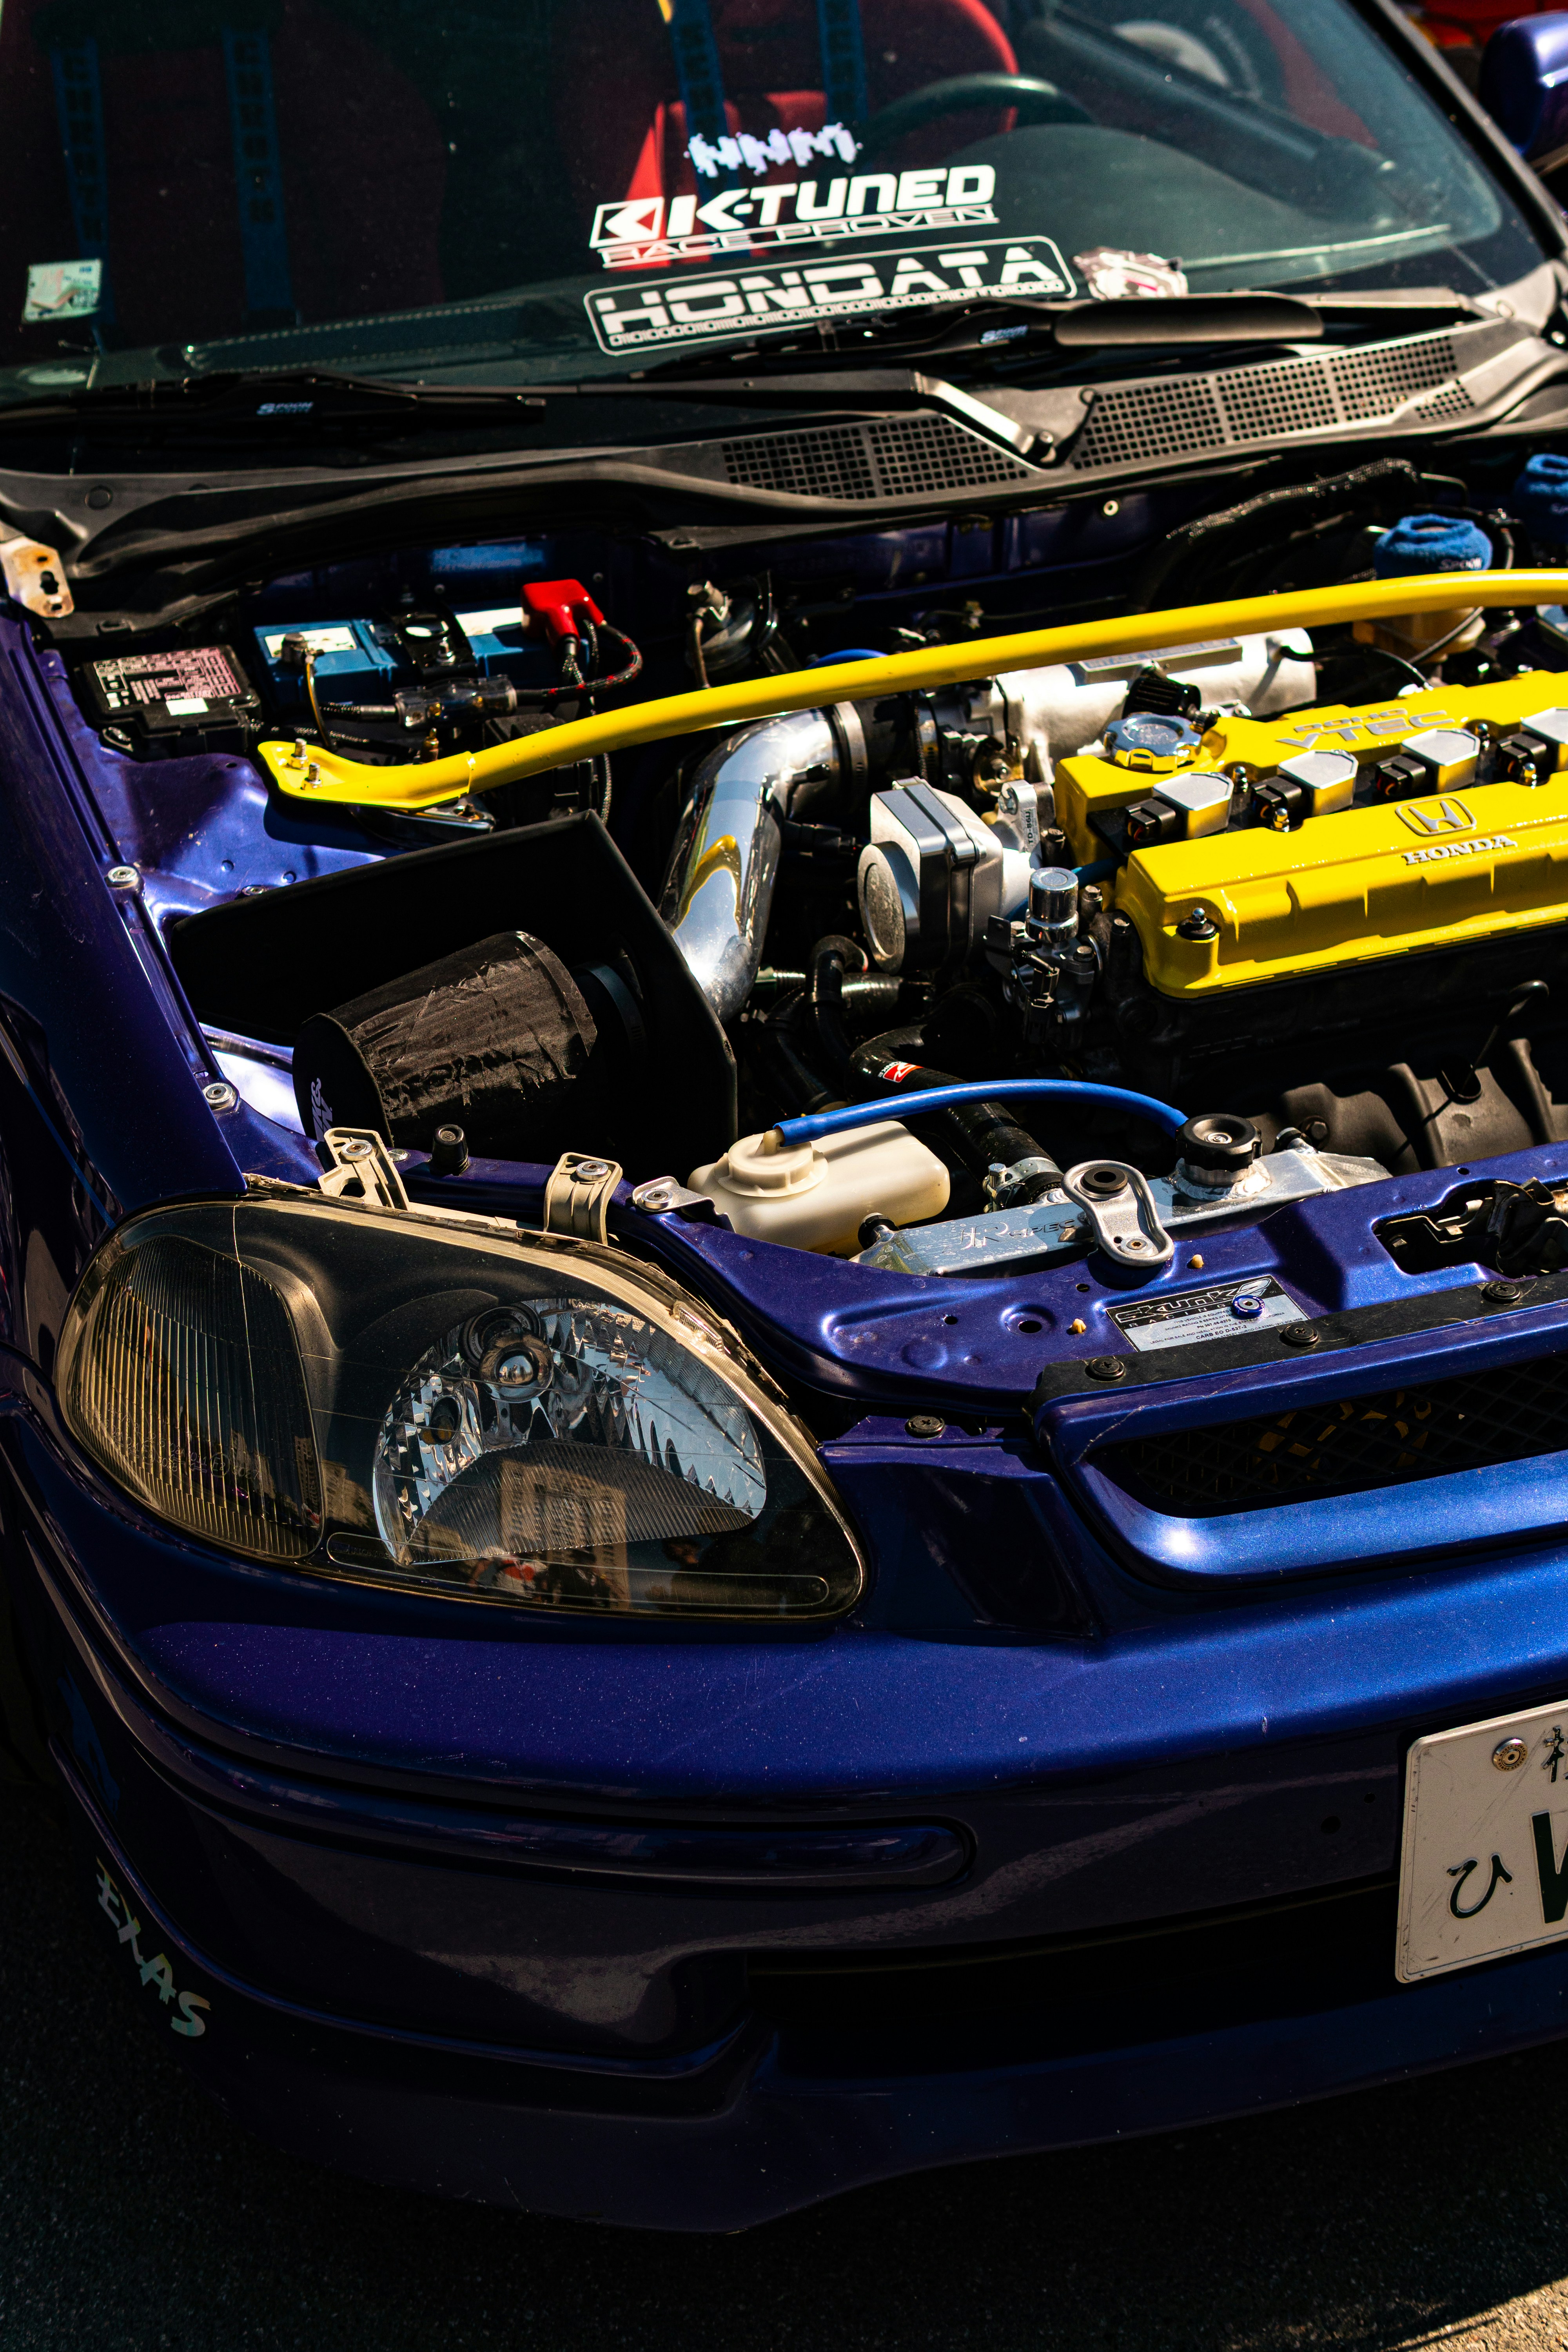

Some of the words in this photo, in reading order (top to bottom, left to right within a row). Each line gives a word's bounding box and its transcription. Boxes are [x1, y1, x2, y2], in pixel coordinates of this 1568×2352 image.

[666, 165, 996, 238] K-TUNED
[775, 205, 996, 241] PROVEN
[595, 247, 1059, 335] HONDATA
[1275, 710, 1455, 750] VTEC
[1293, 708, 1408, 733] DOHC
[1401, 835, 1518, 865] HONDA
[1129, 1303, 1226, 1328] RACING
[1447, 1852, 1512, 1919] ひ
